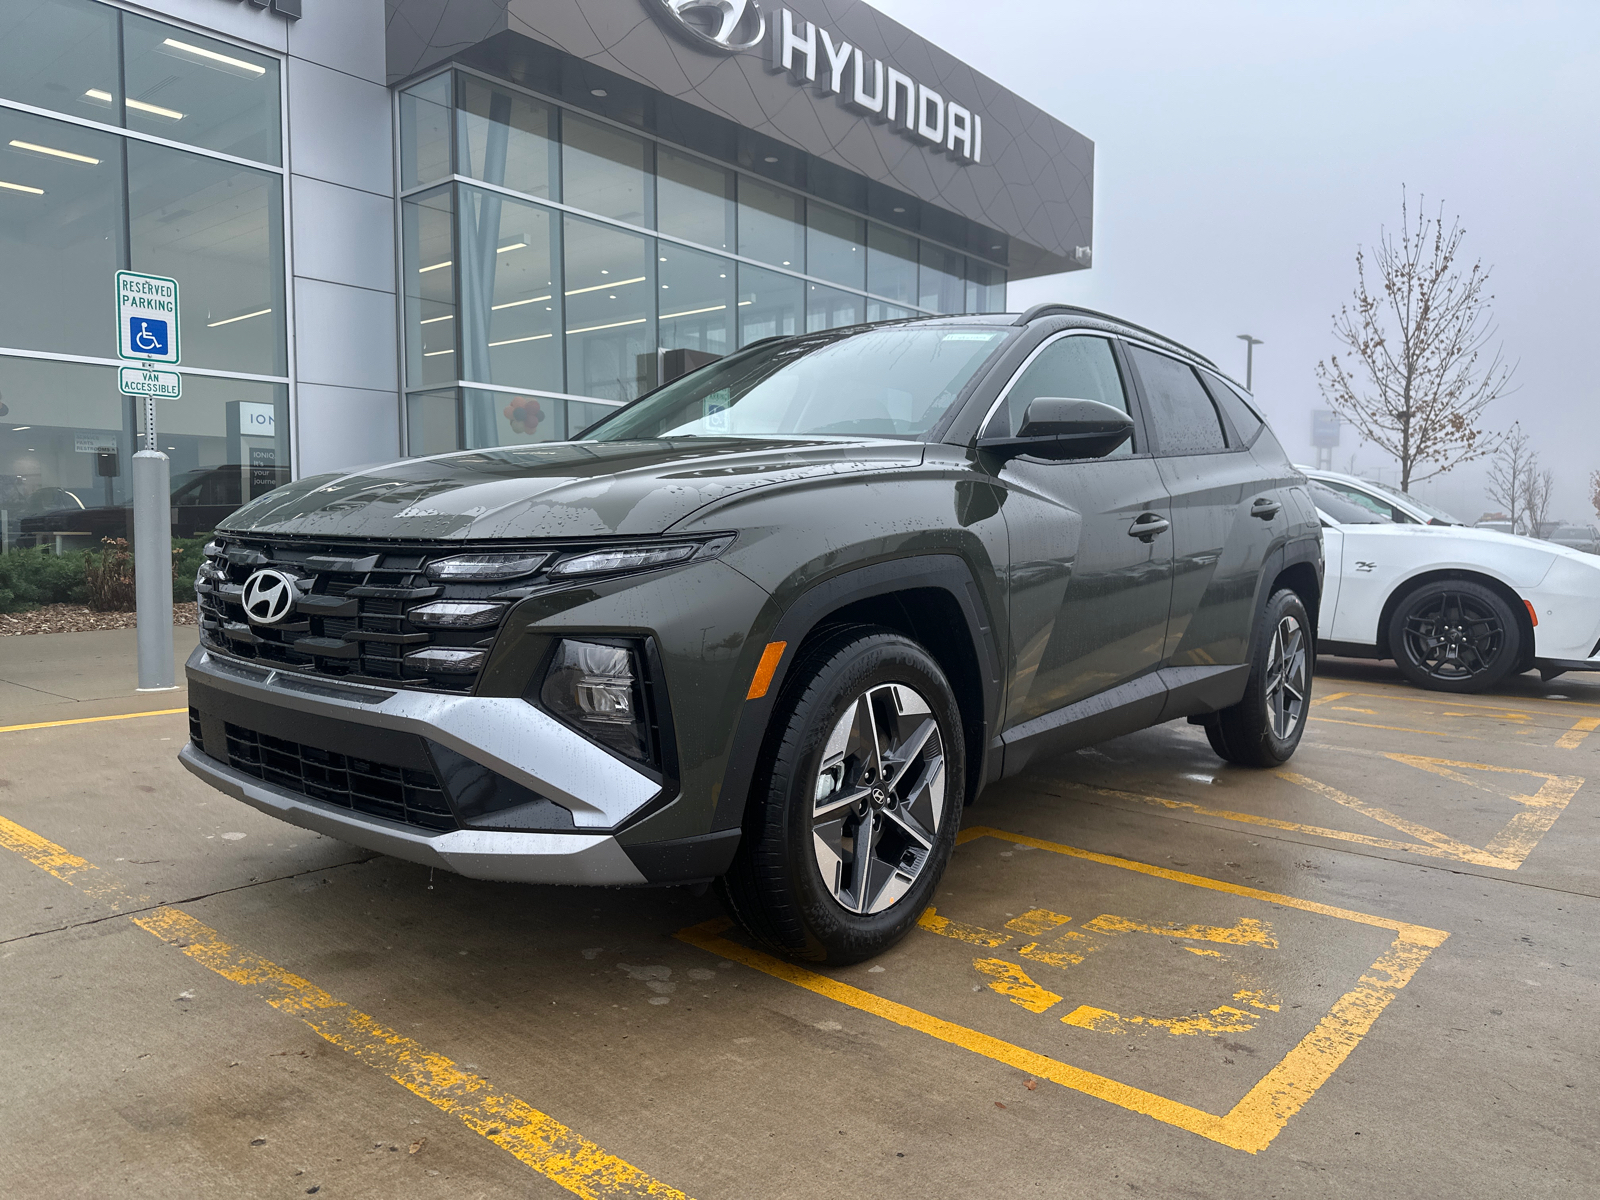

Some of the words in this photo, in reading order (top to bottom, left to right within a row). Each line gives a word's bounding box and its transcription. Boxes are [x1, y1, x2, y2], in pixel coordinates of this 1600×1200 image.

[781, 8, 981, 163] HYUNDAI
[122, 280, 172, 298] RESERVED
[122, 295, 173, 312] PARKING
[142, 373, 159, 382] VAN
[124, 381, 177, 394] ACCESSIBLE
[253, 470, 270, 478] your
